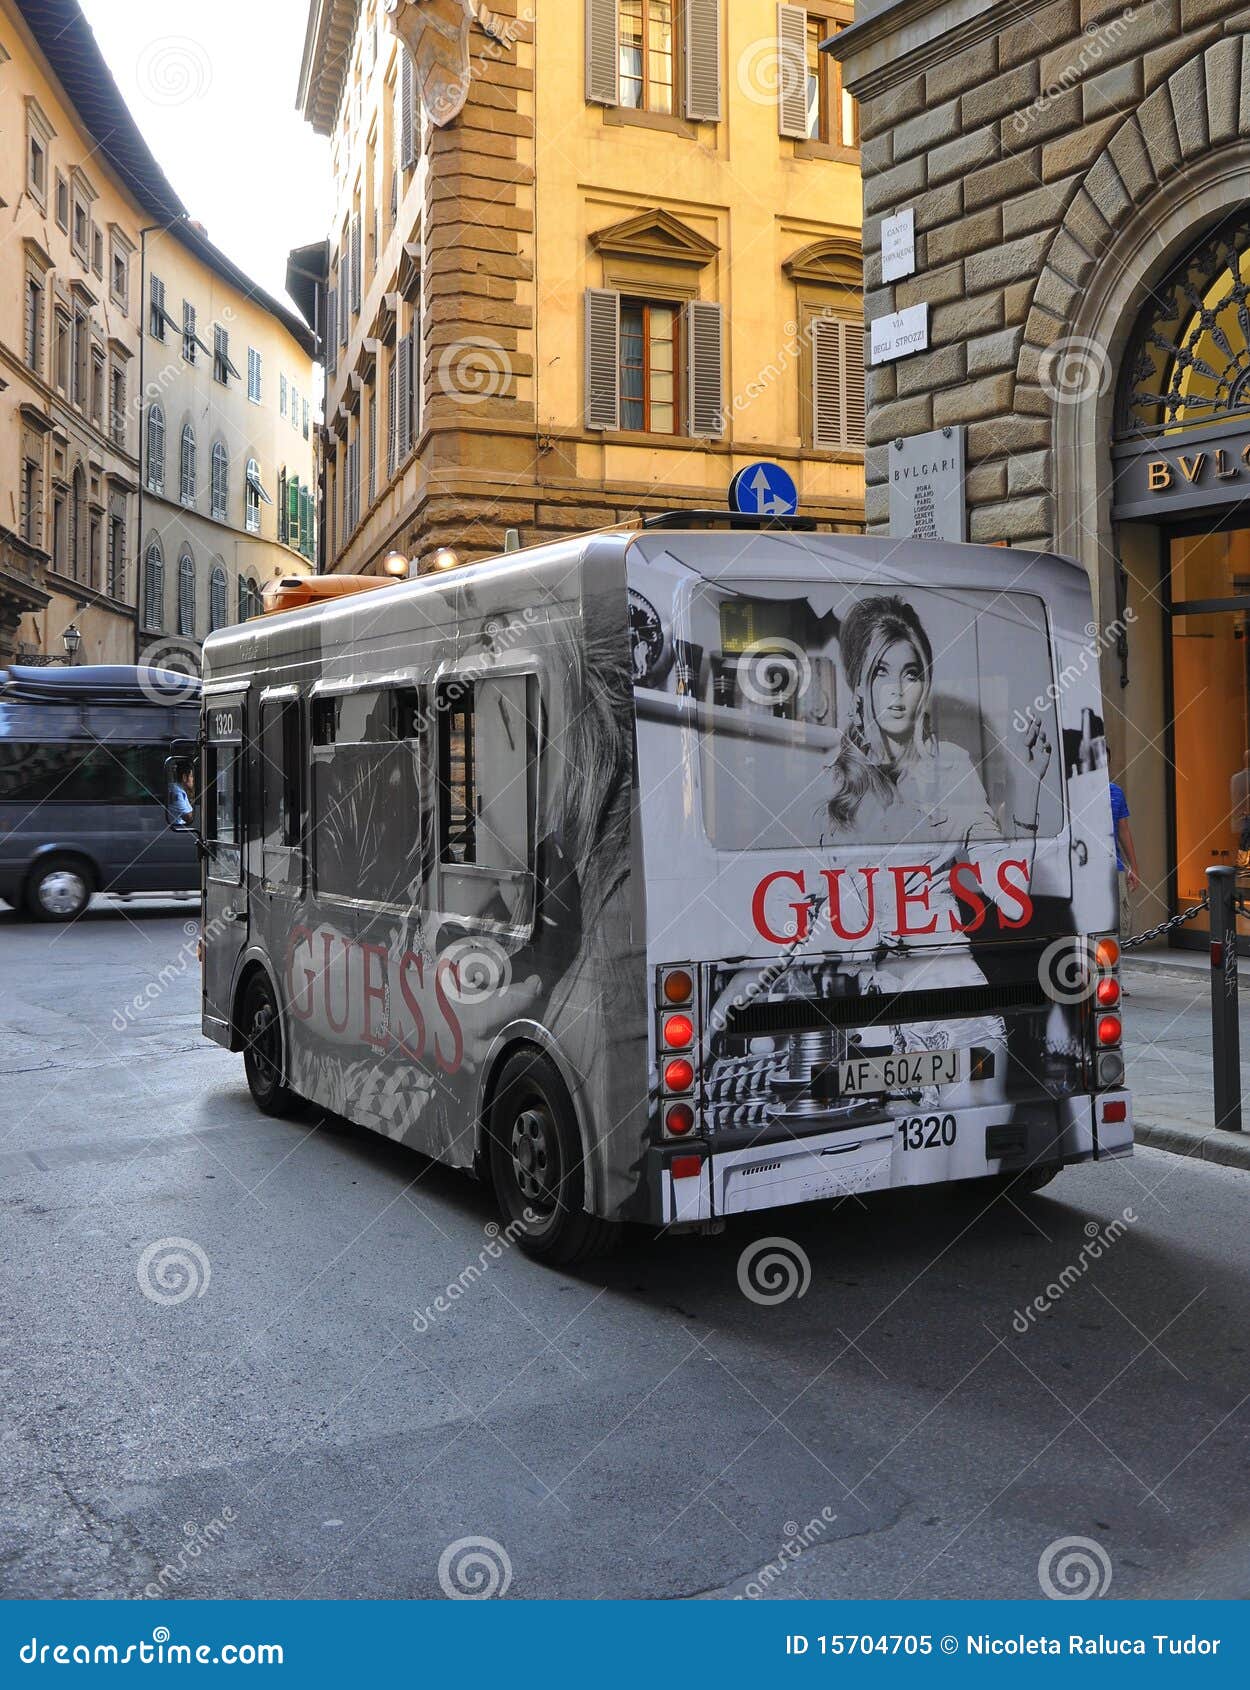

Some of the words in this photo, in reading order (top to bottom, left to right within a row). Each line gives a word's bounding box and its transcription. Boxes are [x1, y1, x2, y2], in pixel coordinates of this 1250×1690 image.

[892, 319, 904, 328] VIA
[873, 341, 891, 354] DEGLI
[895, 330, 924, 347] STROZZI
[894, 458, 955, 480] BVLGARI
[215, 713, 233, 735] 1320
[752, 859, 1034, 945] GUESS
[286, 924, 464, 1075] GUESS
[898, 1114, 957, 1151] 1320
